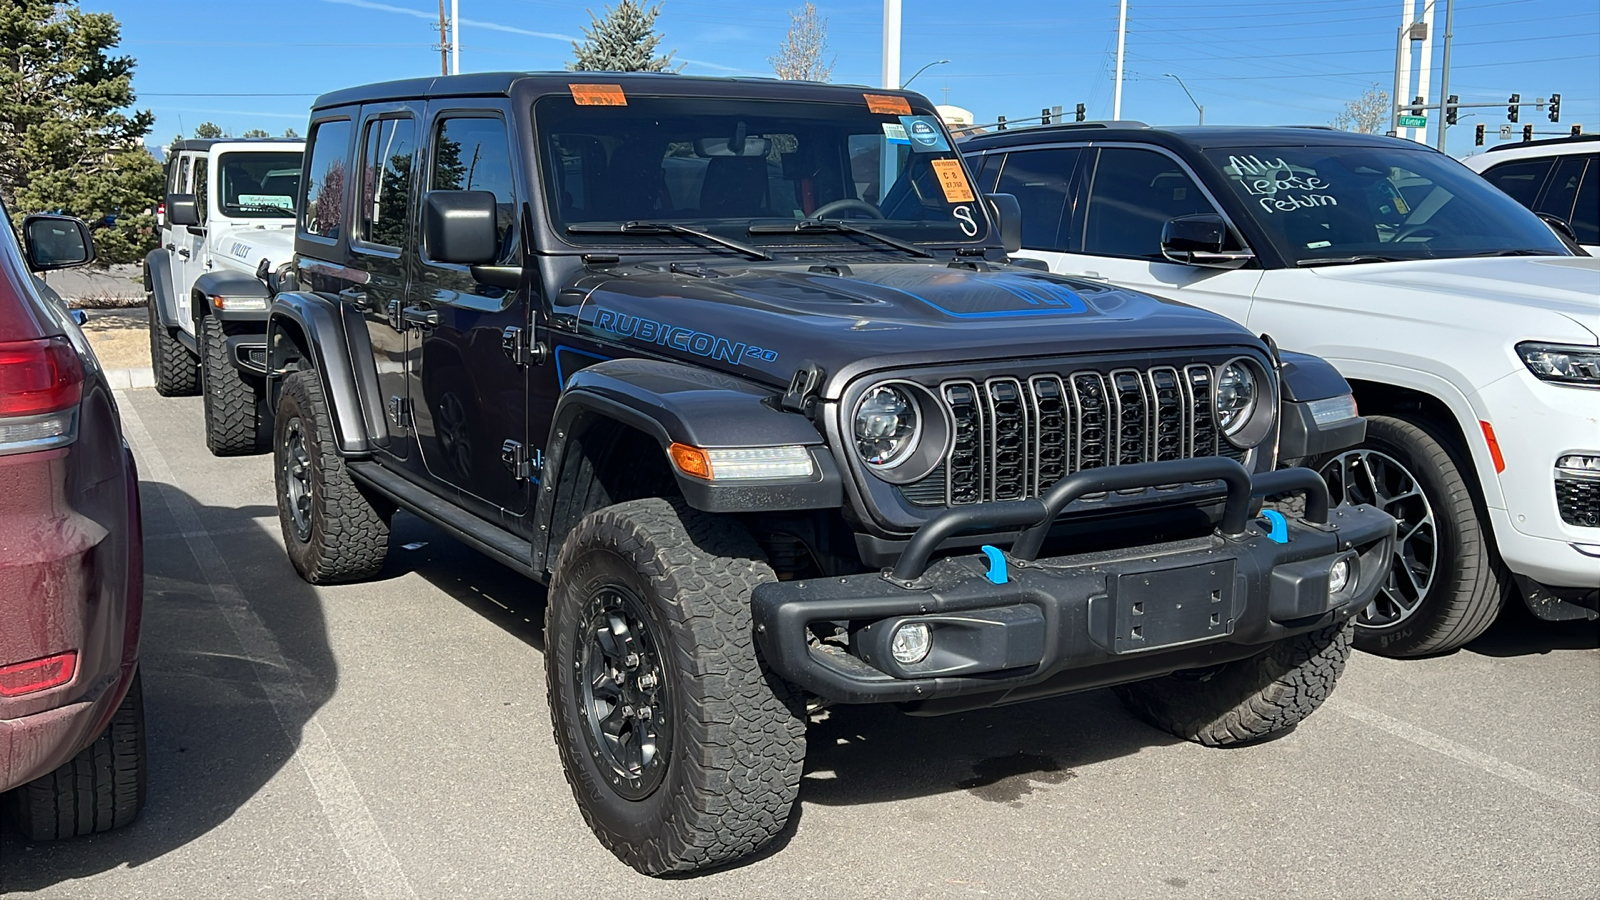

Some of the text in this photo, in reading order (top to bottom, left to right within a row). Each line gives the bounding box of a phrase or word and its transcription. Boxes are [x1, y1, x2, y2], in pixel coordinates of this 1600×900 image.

[1229, 155, 1293, 181] Ally
[1240, 176, 1330, 196] Lease
[1259, 194, 1338, 214] return
[953, 205, 978, 237] 8
[593, 307, 746, 365] RUBICON
